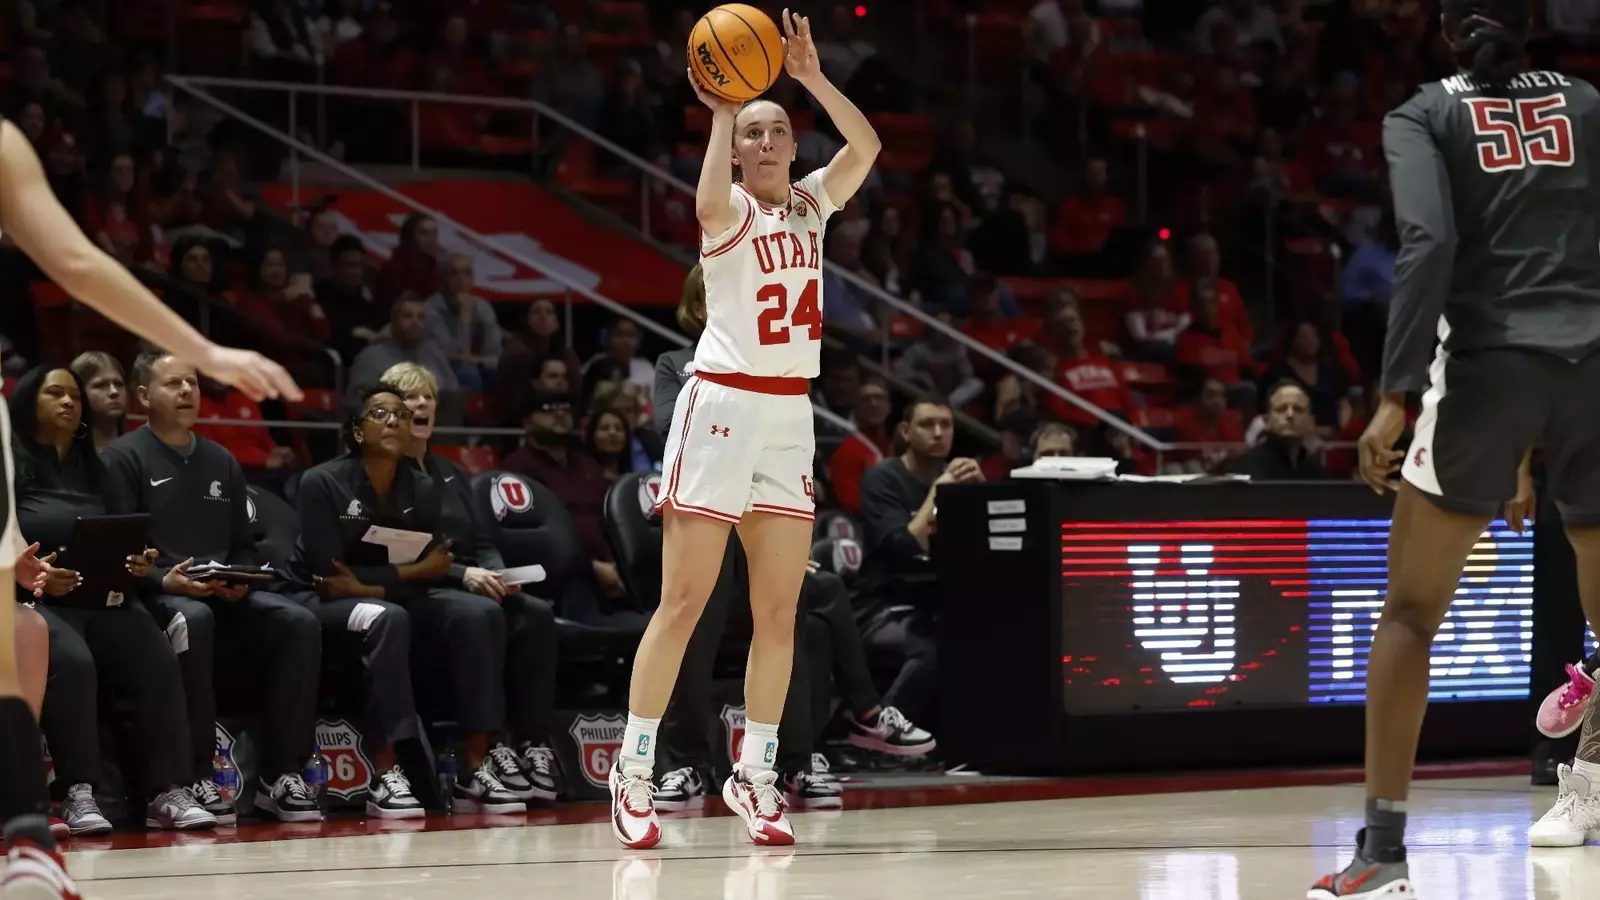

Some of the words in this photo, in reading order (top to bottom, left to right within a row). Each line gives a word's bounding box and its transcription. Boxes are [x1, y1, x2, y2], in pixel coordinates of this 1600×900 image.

[697, 41, 732, 87] NCAA
[1461, 92, 1575, 173] 55
[752, 231, 819, 274] UTAH
[757, 279, 822, 345] 24
[501, 483, 525, 506] U
[317, 732, 352, 746] ILLIPS
[580, 727, 625, 740] PHILLIPS
